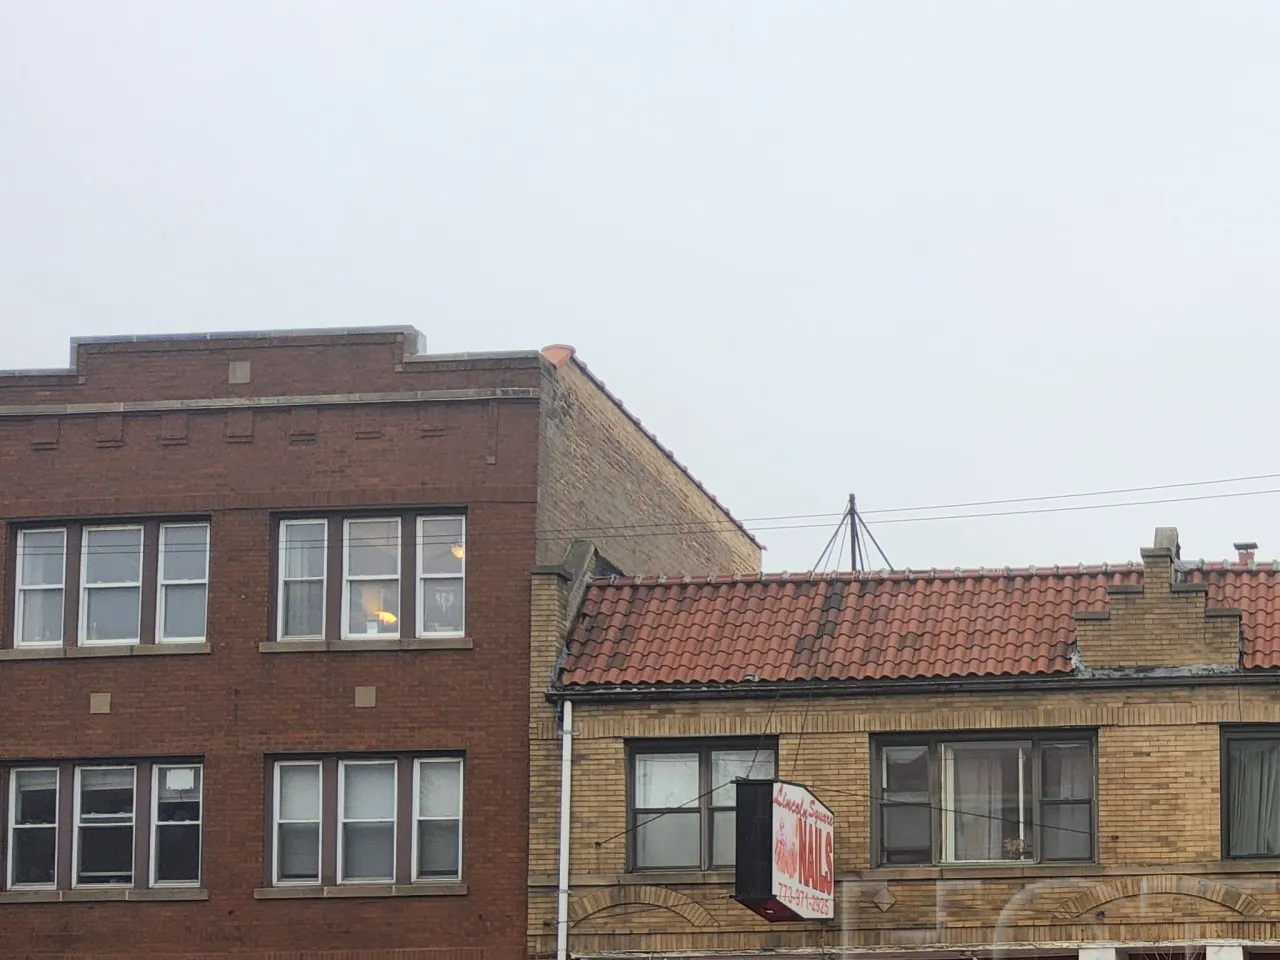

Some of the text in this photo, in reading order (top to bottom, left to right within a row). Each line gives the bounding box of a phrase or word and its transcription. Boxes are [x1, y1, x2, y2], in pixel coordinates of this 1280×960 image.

[774, 783, 833, 826] Lincoln Square
[798, 818, 832, 895] NAILS
[778, 882, 829, 915] 773-971-2925
